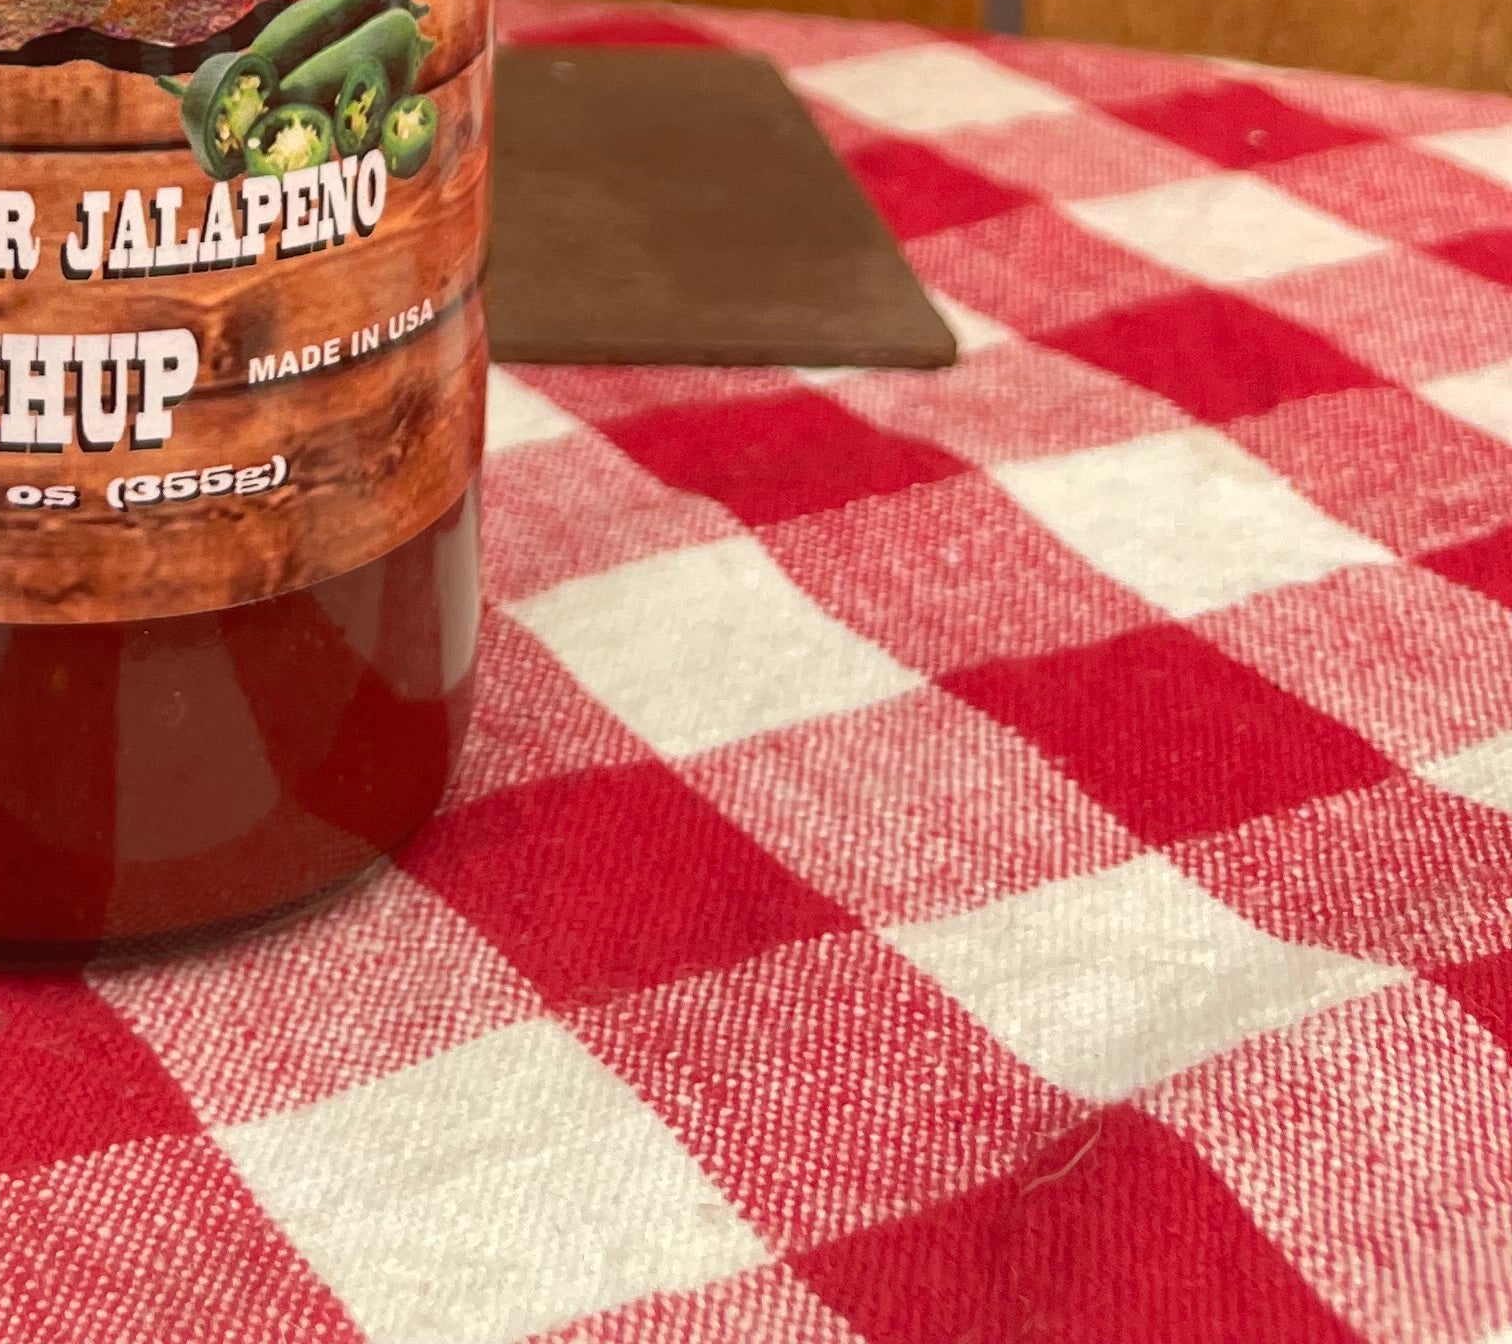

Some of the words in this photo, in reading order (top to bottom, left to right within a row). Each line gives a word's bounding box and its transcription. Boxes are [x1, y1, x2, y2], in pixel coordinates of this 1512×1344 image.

[59, 148, 389, 280] JALAPENO
[248, 337, 341, 384] MADE
[350, 323, 379, 356] IN
[388, 298, 434, 340] USA
[5, 483, 76, 509] os
[104, 455, 290, 511] (355g)
